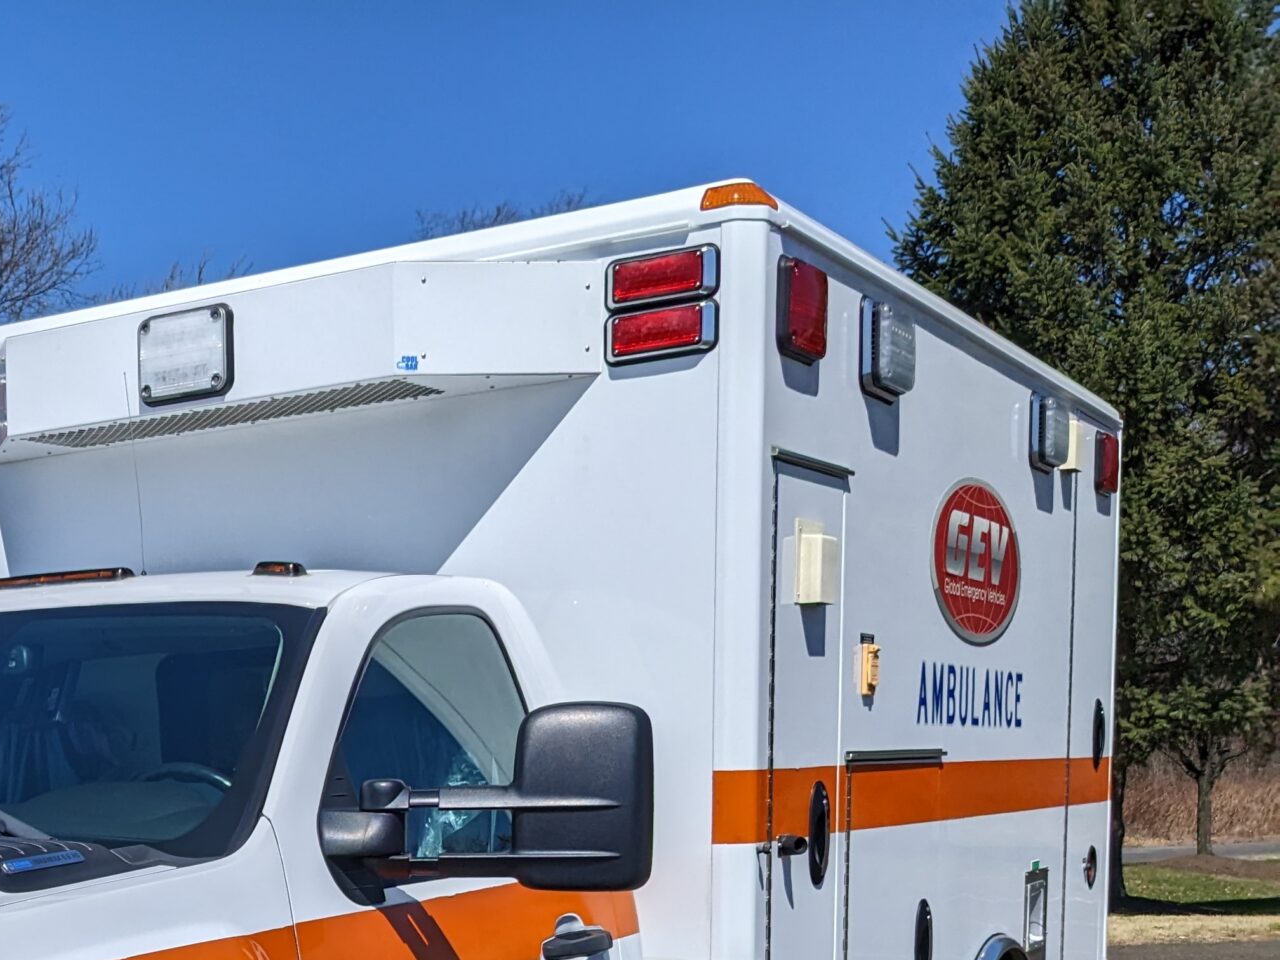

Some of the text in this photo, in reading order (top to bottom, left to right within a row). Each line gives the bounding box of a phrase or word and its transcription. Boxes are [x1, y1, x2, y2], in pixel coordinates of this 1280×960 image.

[945, 509, 1009, 586] GEV
[944, 577, 960, 596] Global
[917, 661, 1023, 728] AMBULANCE
